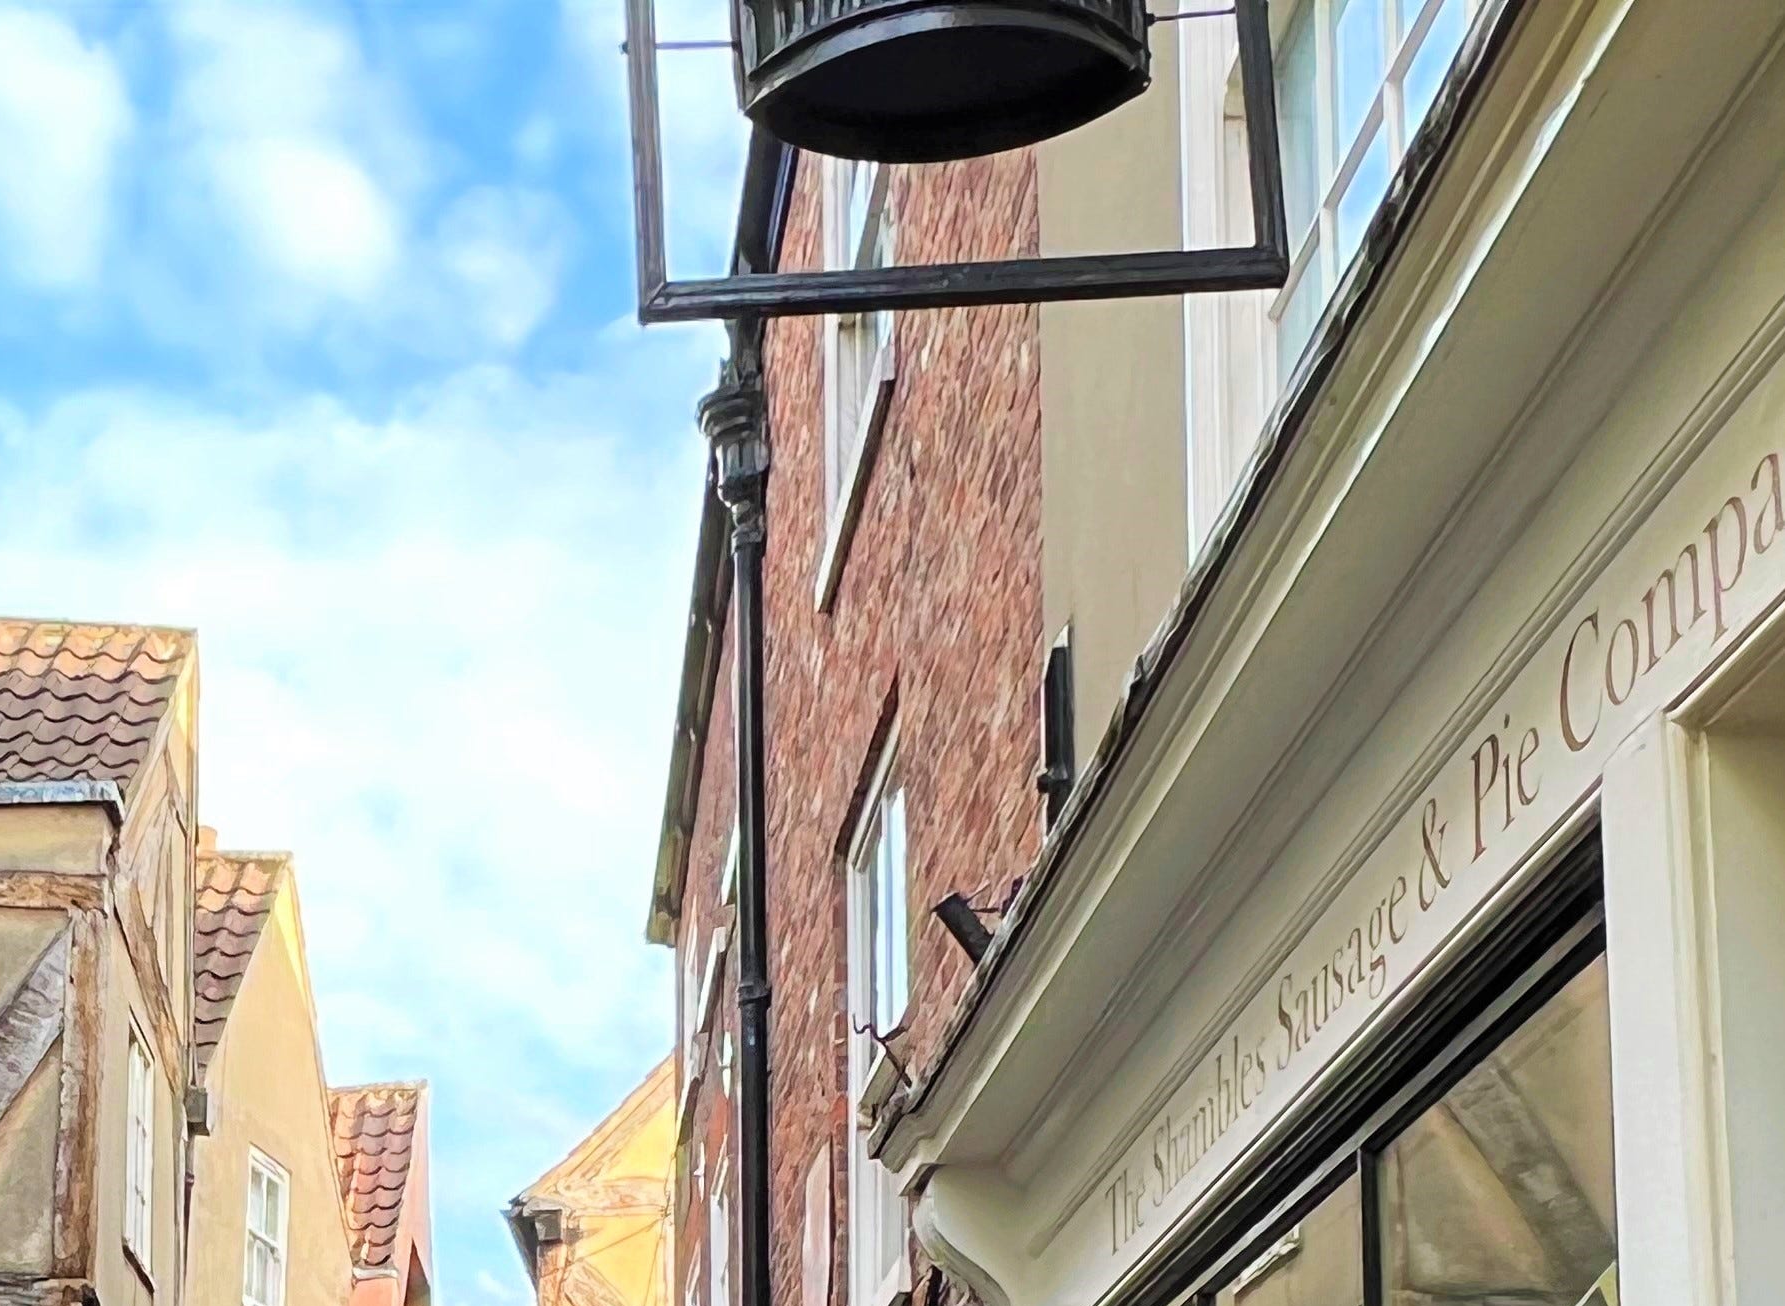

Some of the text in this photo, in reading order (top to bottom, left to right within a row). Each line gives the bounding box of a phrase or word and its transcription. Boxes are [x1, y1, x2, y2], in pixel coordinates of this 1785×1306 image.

[1104, 1167, 1146, 1256] The
[1153, 1035, 1266, 1207] Shambles
[1276, 876, 1407, 1071] Sausage
[1418, 797, 1452, 912] &
[1471, 713, 1542, 864] Pie
